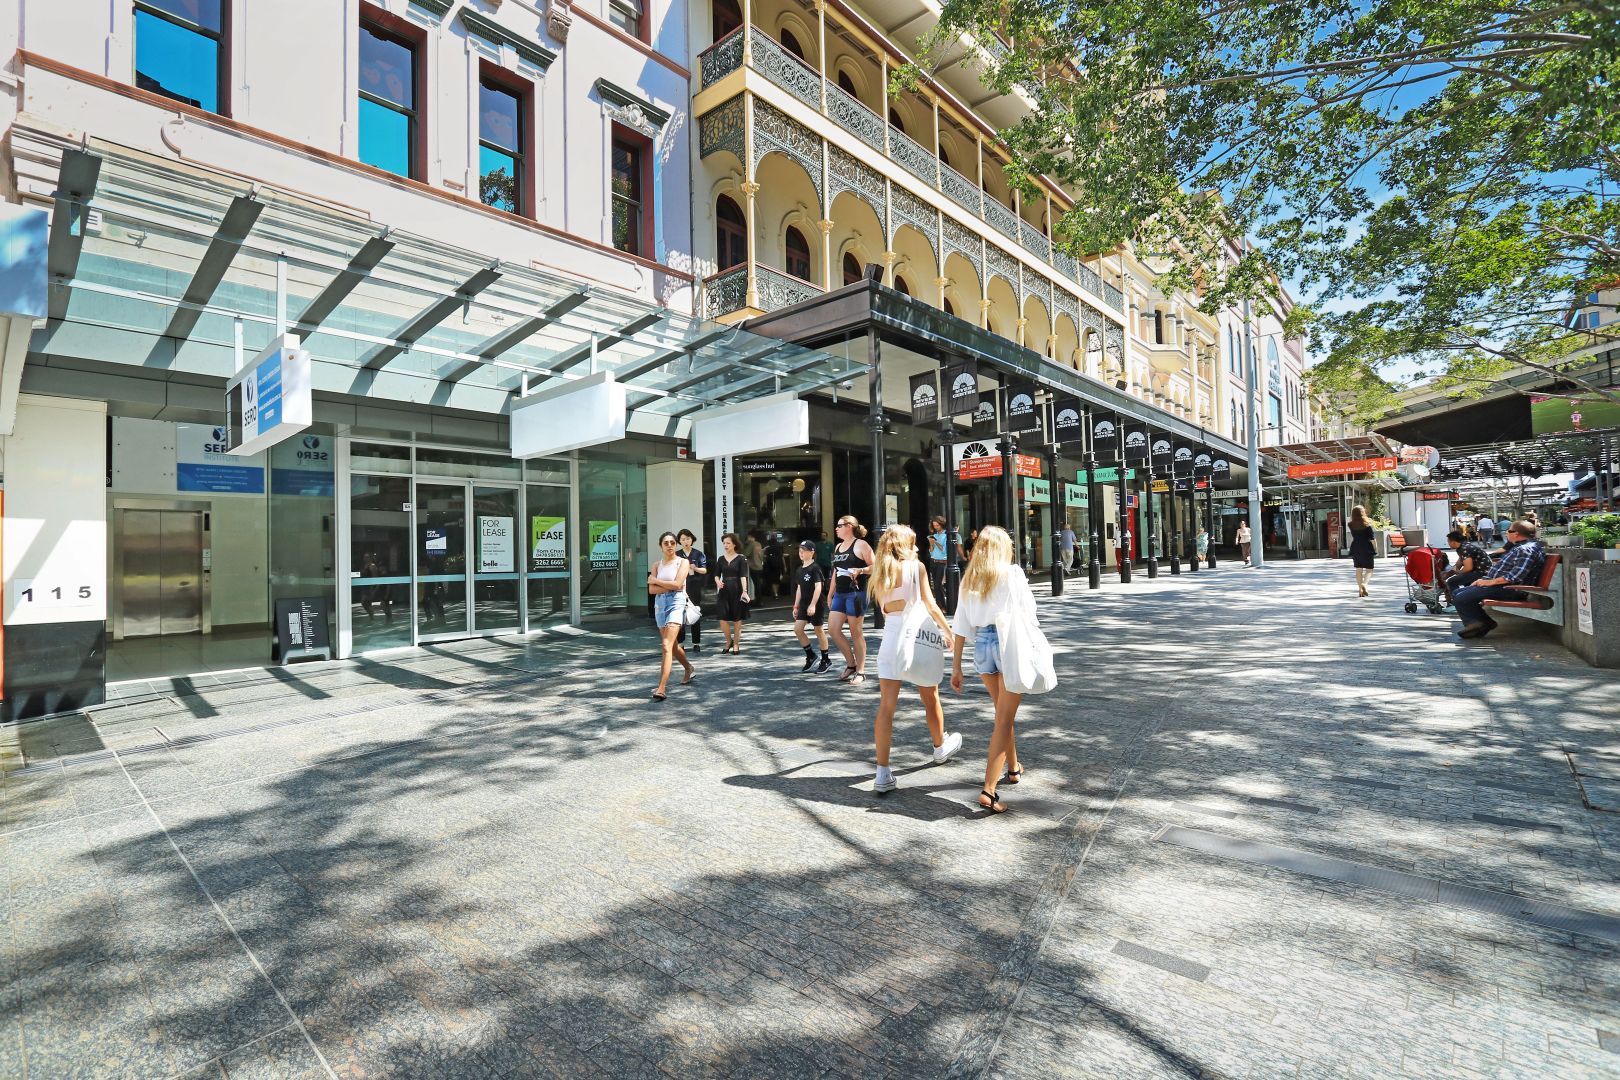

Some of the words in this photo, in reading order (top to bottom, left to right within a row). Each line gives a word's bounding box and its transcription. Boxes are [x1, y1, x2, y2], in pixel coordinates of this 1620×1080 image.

[244, 406, 256, 426] SERO
[536, 531, 563, 540] LEASE
[22, 586, 92, 602] 115
